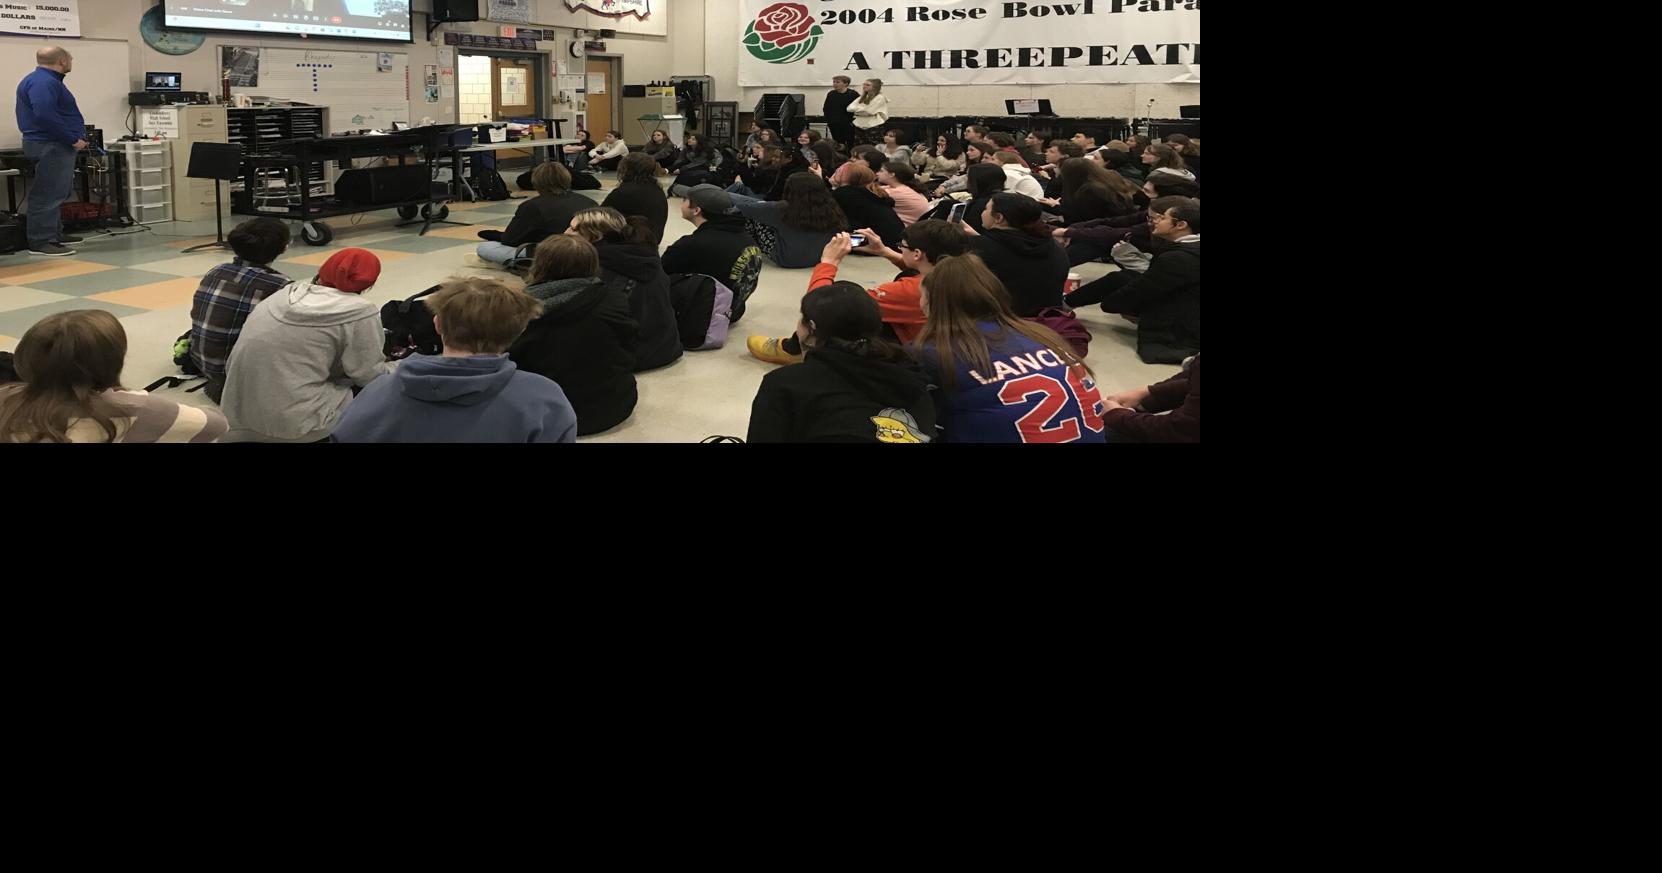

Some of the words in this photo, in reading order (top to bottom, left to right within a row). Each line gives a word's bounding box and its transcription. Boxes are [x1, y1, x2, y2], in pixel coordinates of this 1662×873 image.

[820, 8, 895, 26] 2004
[905, 6, 987, 22] Rose
[1001, 0, 1096, 19] Bowl
[503, 26, 514, 37] EXIT
[843, 51, 872, 70] A
